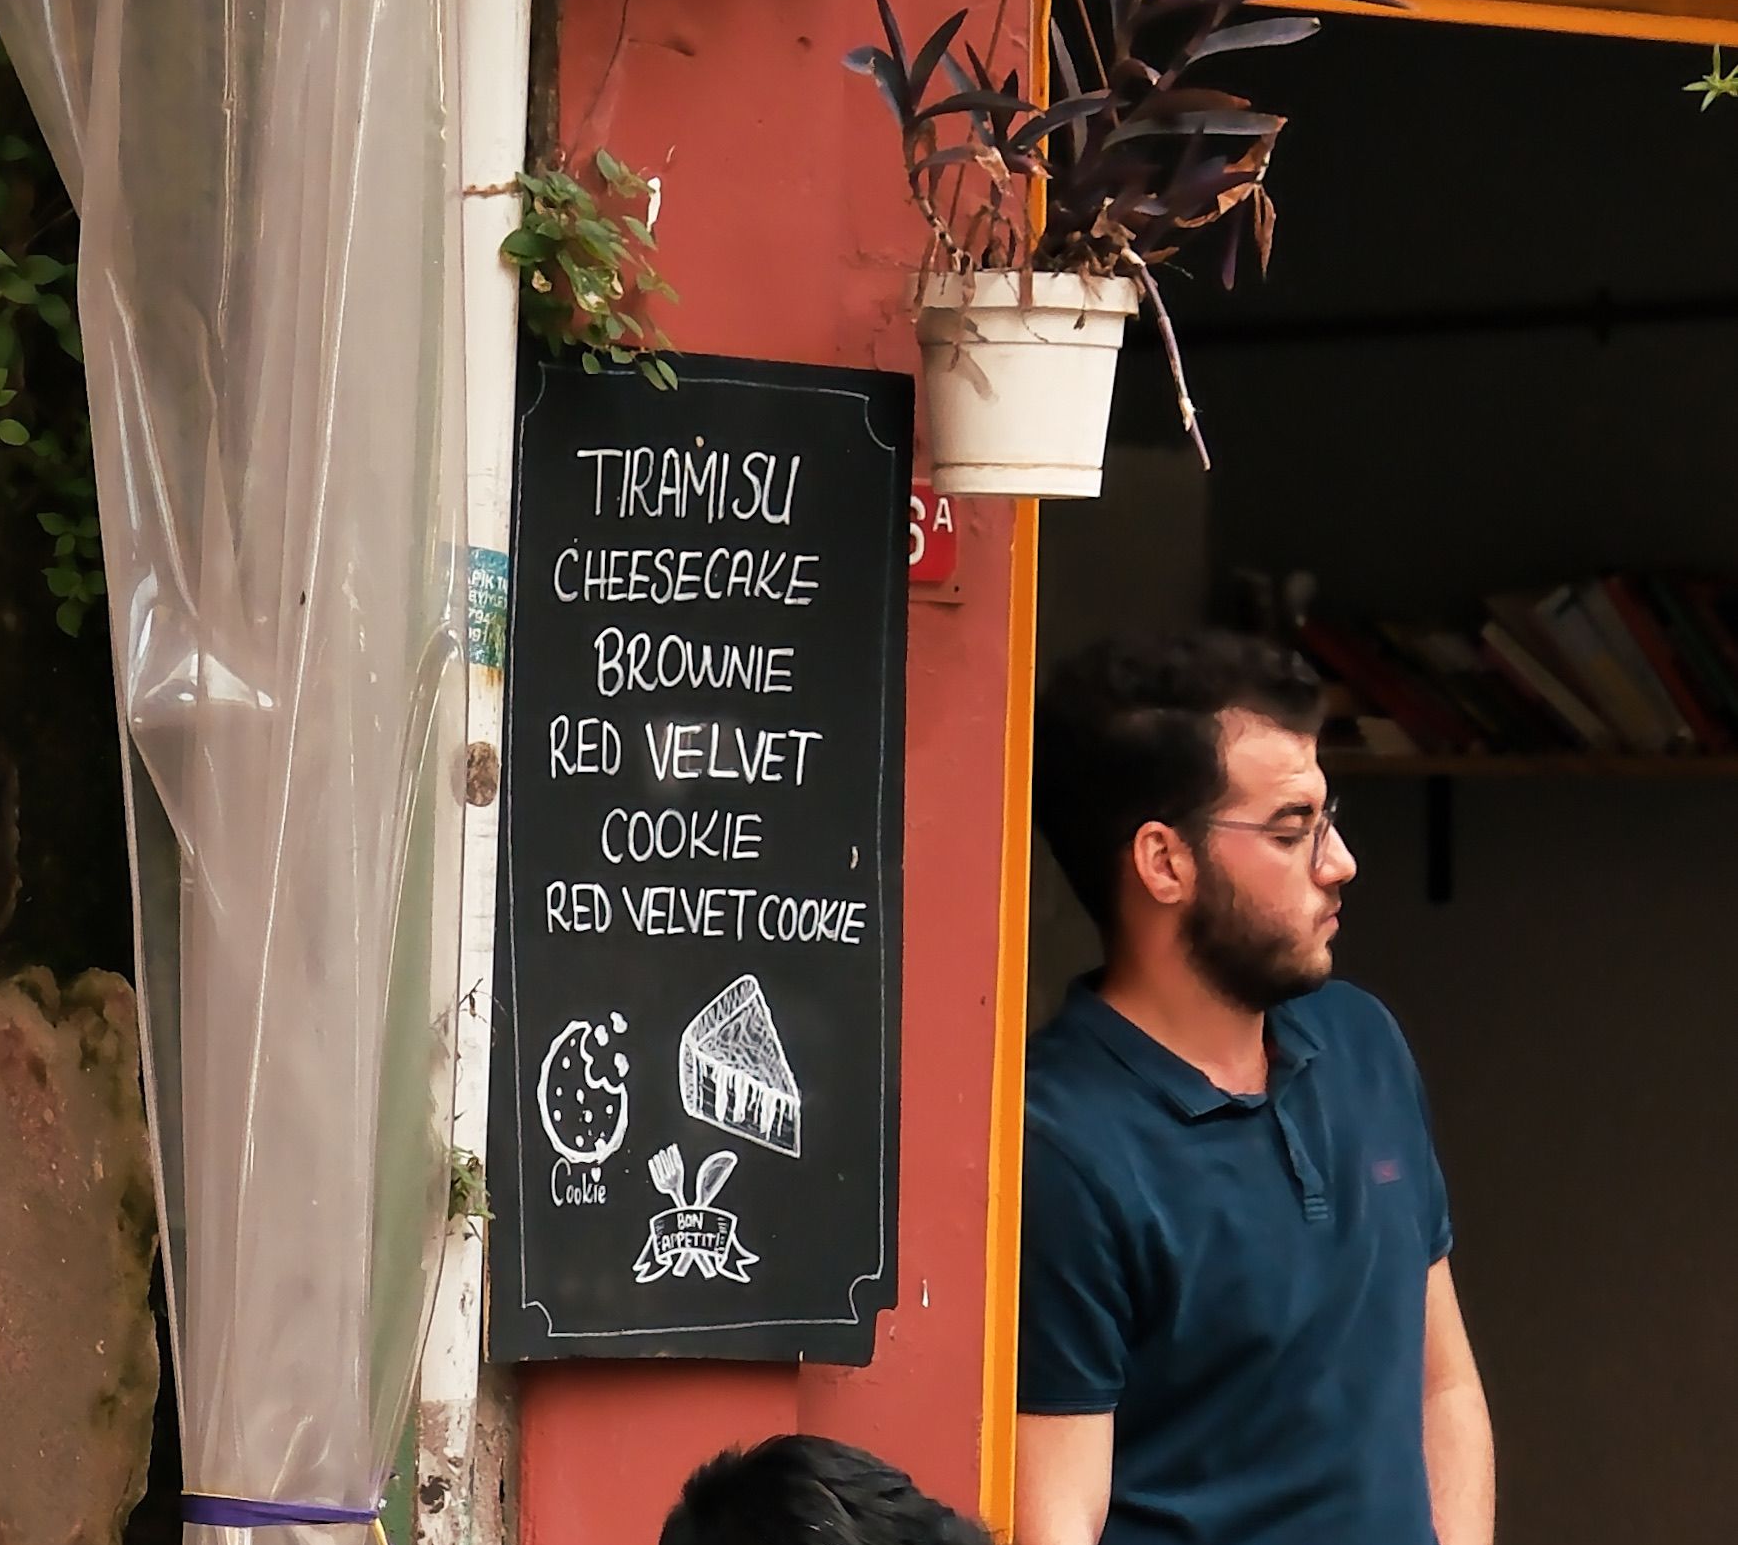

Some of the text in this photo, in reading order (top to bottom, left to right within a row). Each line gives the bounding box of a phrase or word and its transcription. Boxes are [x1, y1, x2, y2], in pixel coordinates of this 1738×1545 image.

[577, 446, 801, 525] TIRAMISU
[553, 547, 820, 606] CHEESECAKE
[594, 626, 795, 697] BROWNIE
[550, 714, 823, 786] RED VELVET
[601, 807, 762, 864] COOKIE
[546, 881, 867, 944] RED VELVET COOKIE
[551, 1156, 607, 1207] Cookie
[677, 1212, 705, 1230] BON
